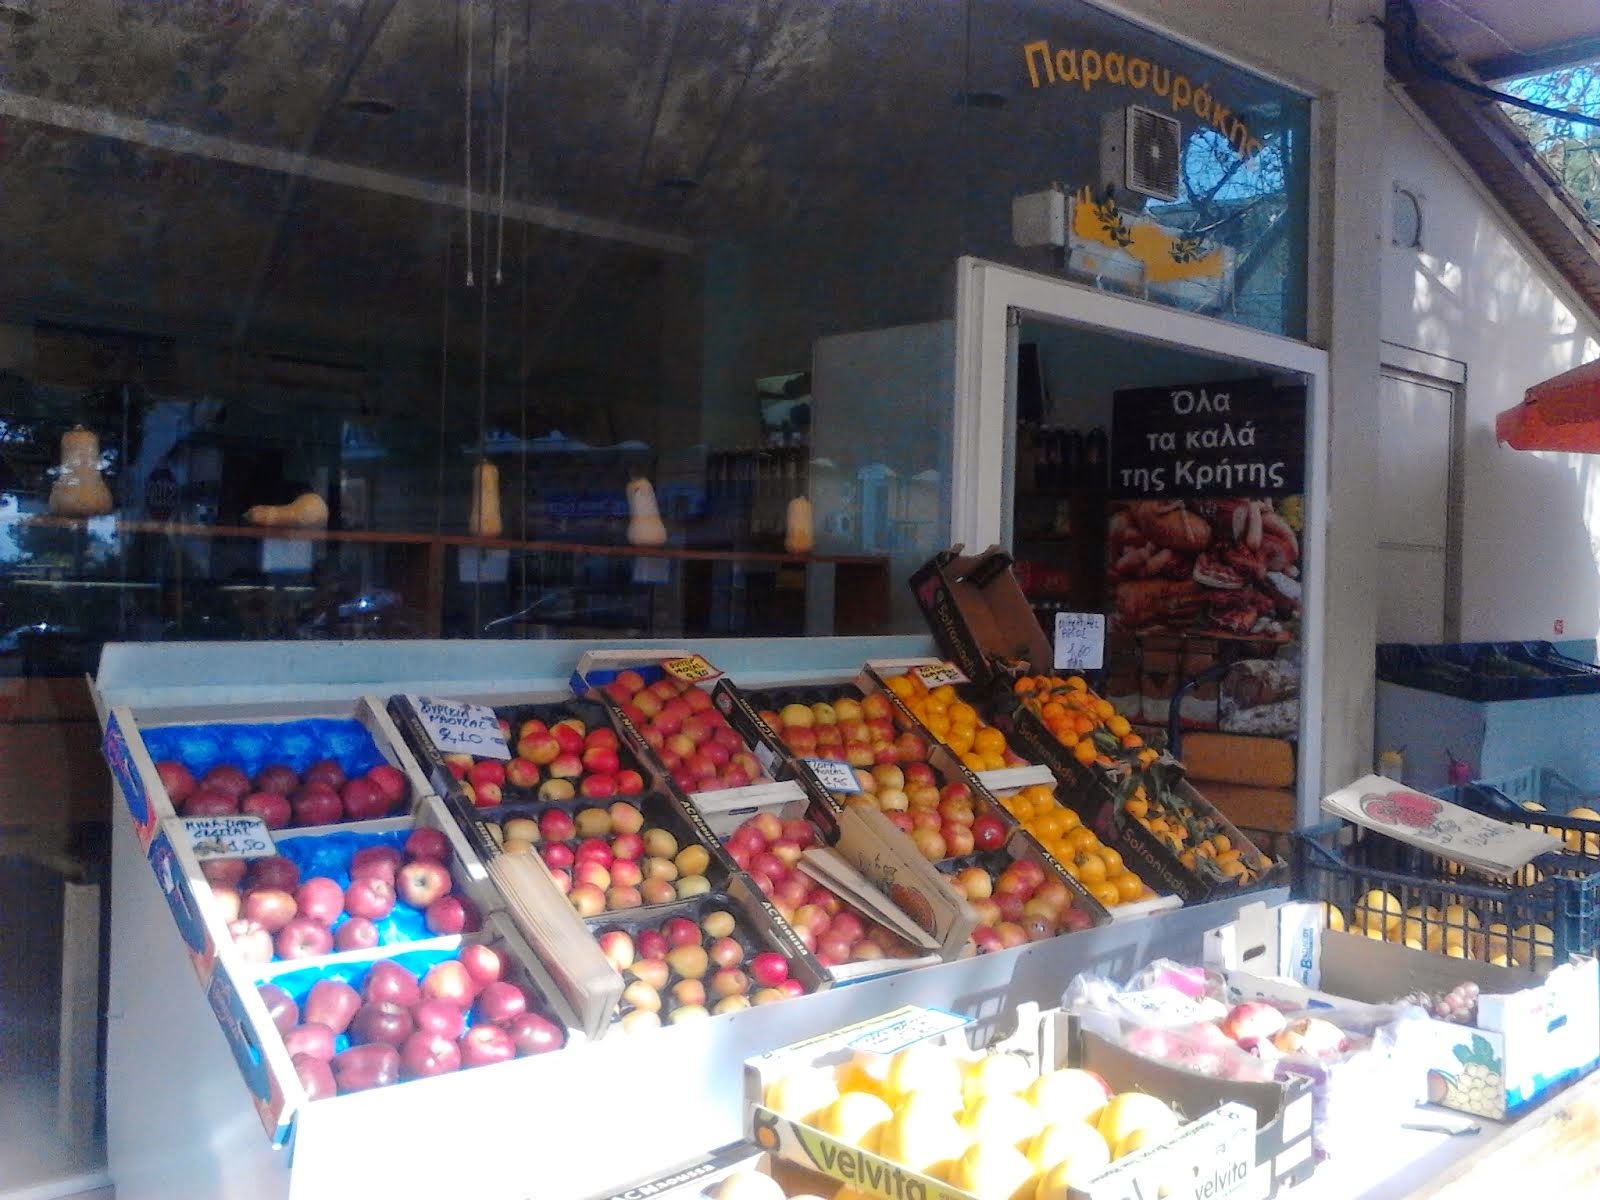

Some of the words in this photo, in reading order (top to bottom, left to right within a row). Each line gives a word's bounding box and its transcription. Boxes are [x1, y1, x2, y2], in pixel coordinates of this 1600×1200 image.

[1171, 388, 1231, 415] Όλα
[1147, 431, 1176, 451] τα
[1186, 420, 1256, 449] καλά
[1119, 467, 1167, 492] της
[1175, 457, 1286, 490] Κρήτης
[820, 1140, 927, 1200] velvita
[1195, 1160, 1248, 1200] velvita
